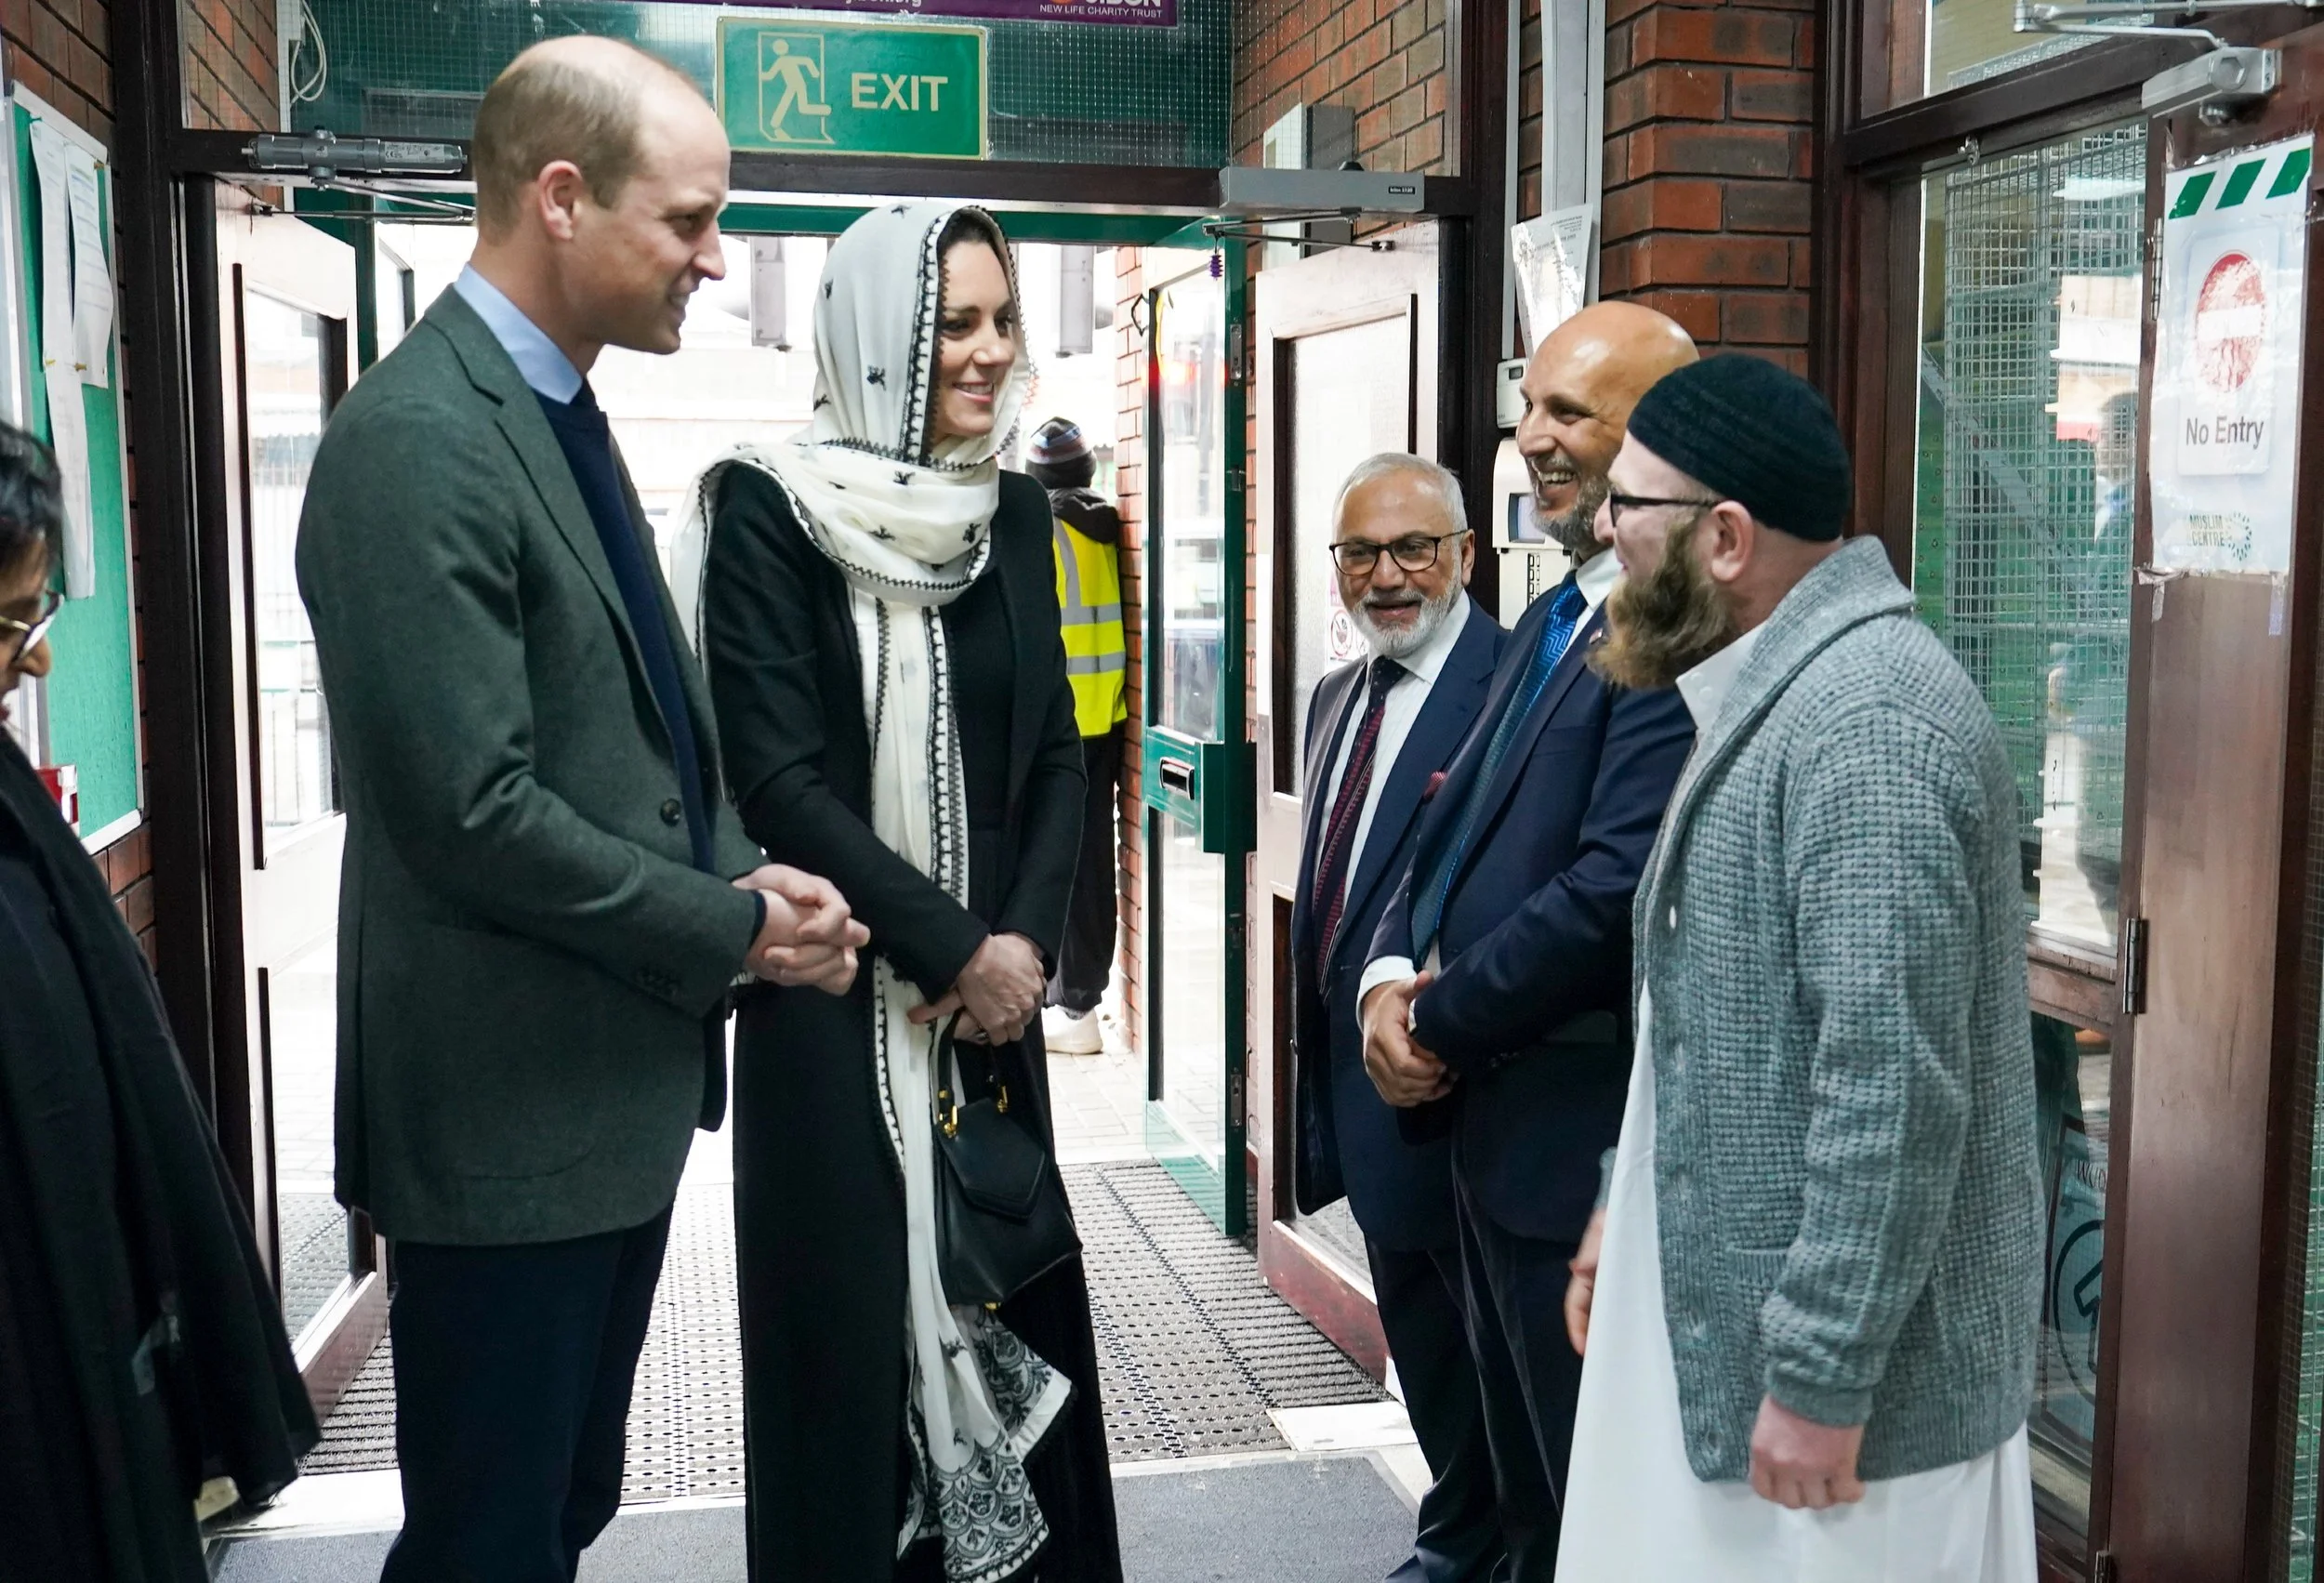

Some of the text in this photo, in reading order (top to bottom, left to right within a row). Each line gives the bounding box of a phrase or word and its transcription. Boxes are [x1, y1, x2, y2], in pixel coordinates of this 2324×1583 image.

[1040, 5, 1163, 18] NEW LIFE CHARITY TRUST
[852, 73, 948, 112] EXIT
[2186, 416, 2264, 450] No Entry
[2190, 514, 2223, 530] MUSLIM
[2192, 531, 2225, 547] CENTRE
